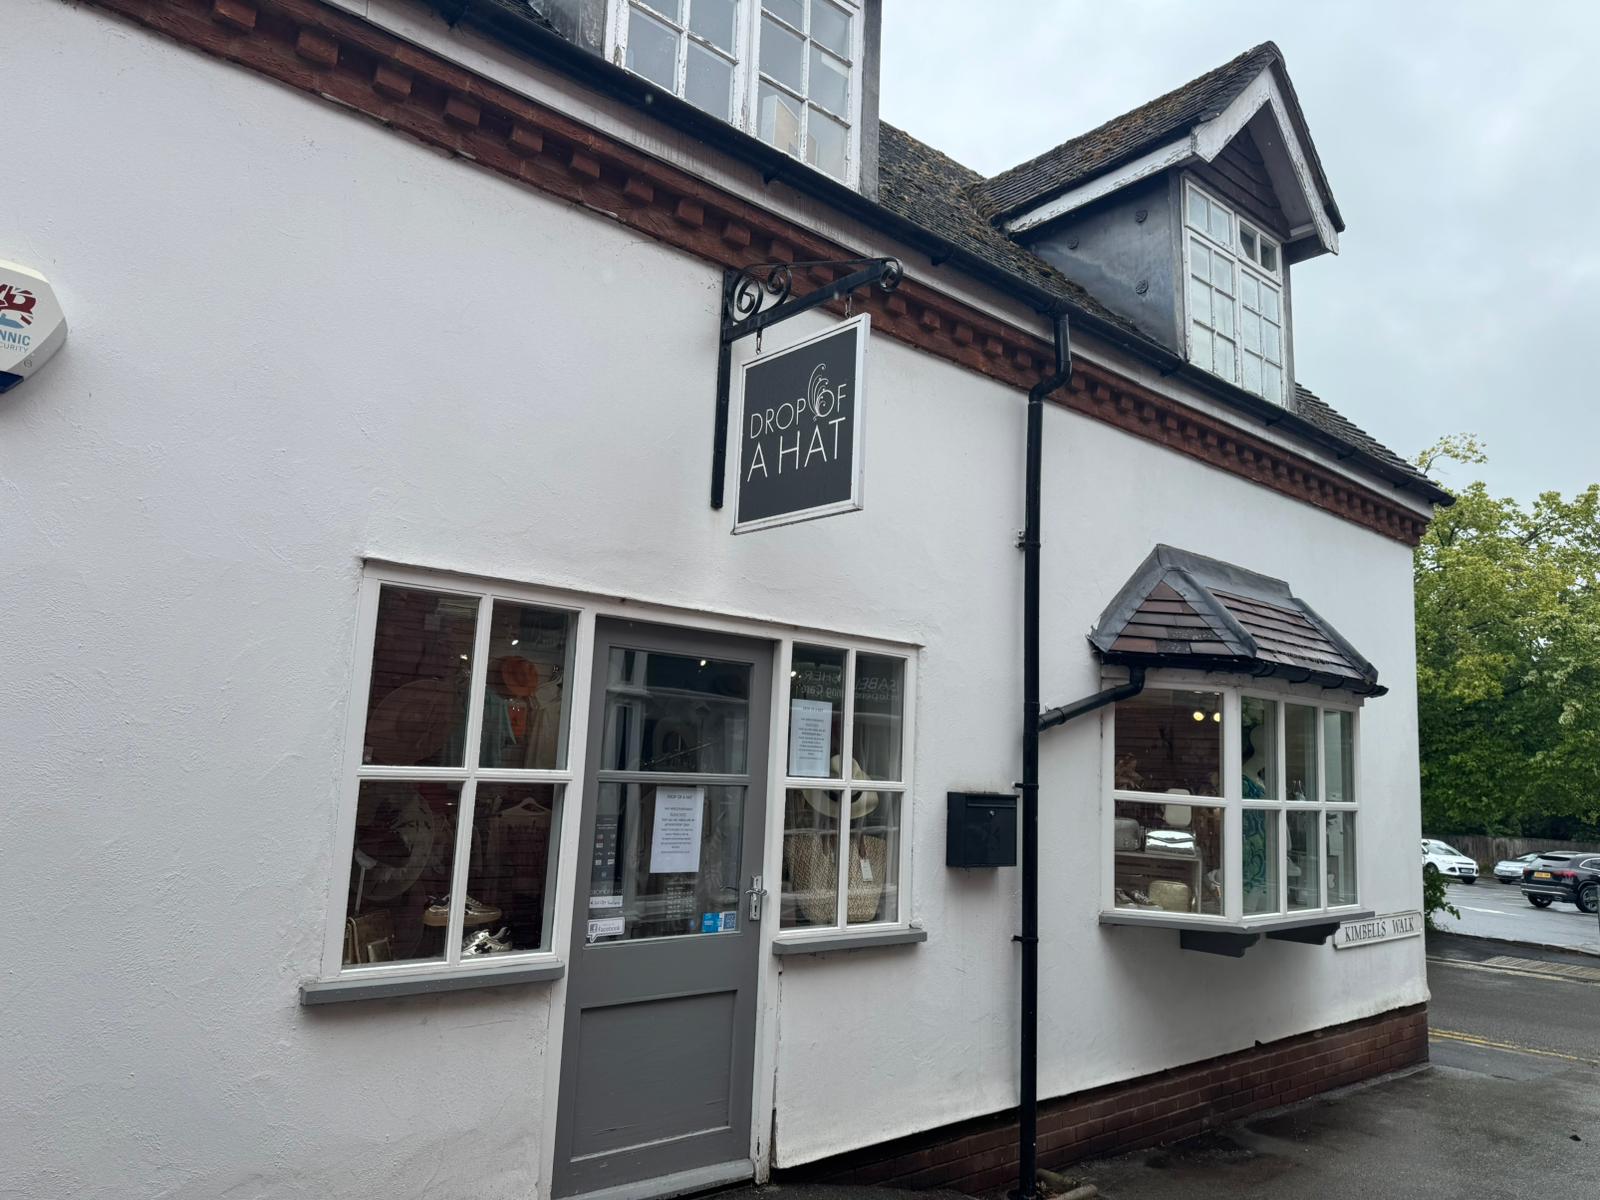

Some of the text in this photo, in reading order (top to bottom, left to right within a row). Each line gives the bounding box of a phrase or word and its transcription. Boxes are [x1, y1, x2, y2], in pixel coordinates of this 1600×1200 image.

[751, 383, 847, 439] DROP OF
[747, 416, 846, 483] A HAT
[1344, 917, 1414, 942] KIMBELLS WALK
